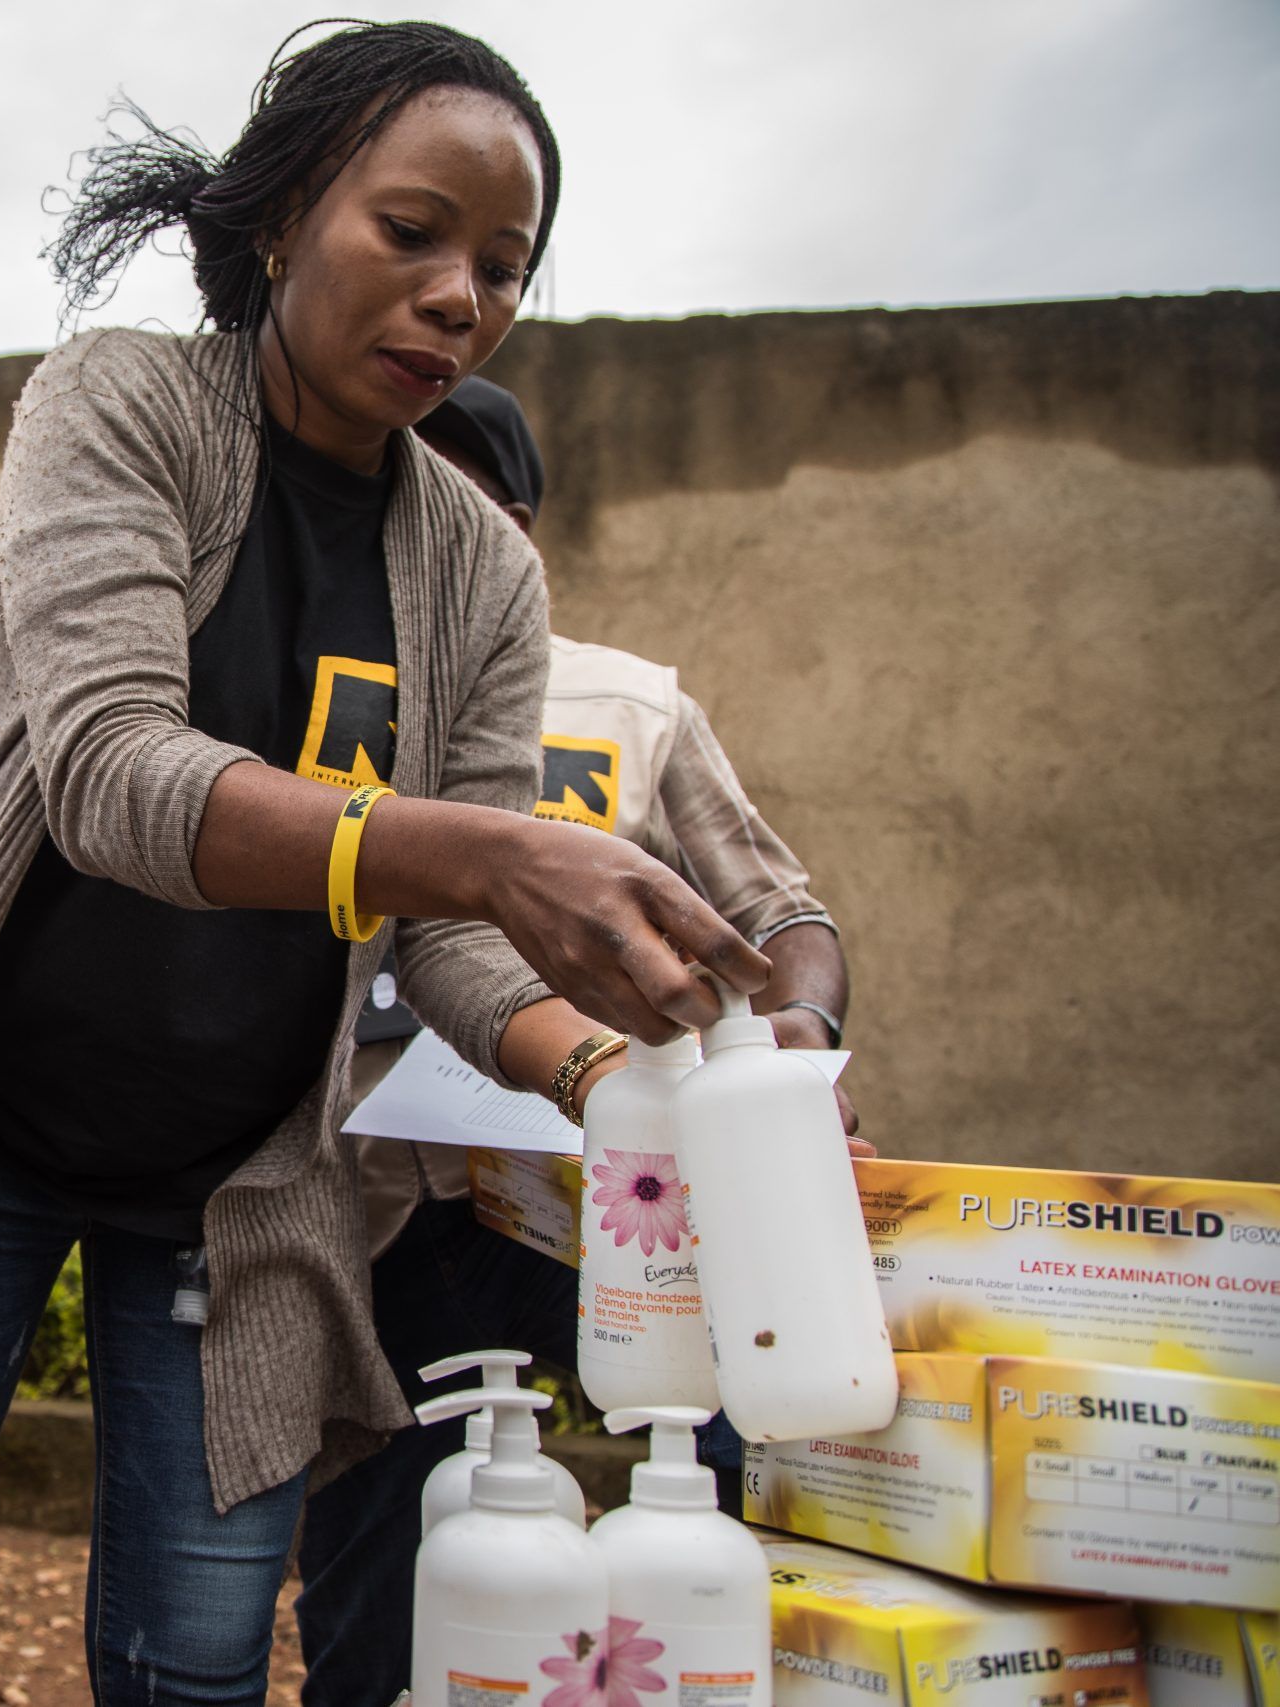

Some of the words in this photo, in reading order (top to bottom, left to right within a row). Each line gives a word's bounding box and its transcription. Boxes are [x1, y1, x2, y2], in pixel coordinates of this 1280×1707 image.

[311, 770, 366, 787] INTERNA
[337, 904, 351, 938] Home
[958, 1193, 1225, 1240] PURESHIELD
[1230, 1223, 1280, 1245] POW
[644, 1261, 698, 1283] Everyda
[873, 1256, 896, 1269] 485
[936, 1275, 974, 1287] Natural
[975, 1278, 1015, 1290] Rubber
[1016, 1281, 1045, 1292] Latex
[1020, 1260, 1077, 1278] LATEX
[1082, 1265, 1210, 1289] EXAMINATION
[594, 1282, 643, 1301] Vloeibare
[646, 1291, 702, 1304] handzeep
[594, 1294, 626, 1310] Crème
[629, 1300, 673, 1314] lavante
[676, 1304, 702, 1317] pour
[594, 1305, 606, 1316] les
[608, 1309, 640, 1323] mains
[593, 1328, 608, 1342] 500
[609, 1332, 620, 1344] ml
[594, 1317, 610, 1327] Liquid
[611, 1320, 628, 1330] hand
[629, 1324, 647, 1333] soap
[998, 1385, 1188, 1428] PURESHIELD
[809, 1440, 832, 1456] LATEX
[833, 1443, 888, 1464] EXAMINATION
[889, 1451, 920, 1471] GLOVE
[745, 1471, 760, 1496] CE
[773, 1648, 844, 1684] POWDER
